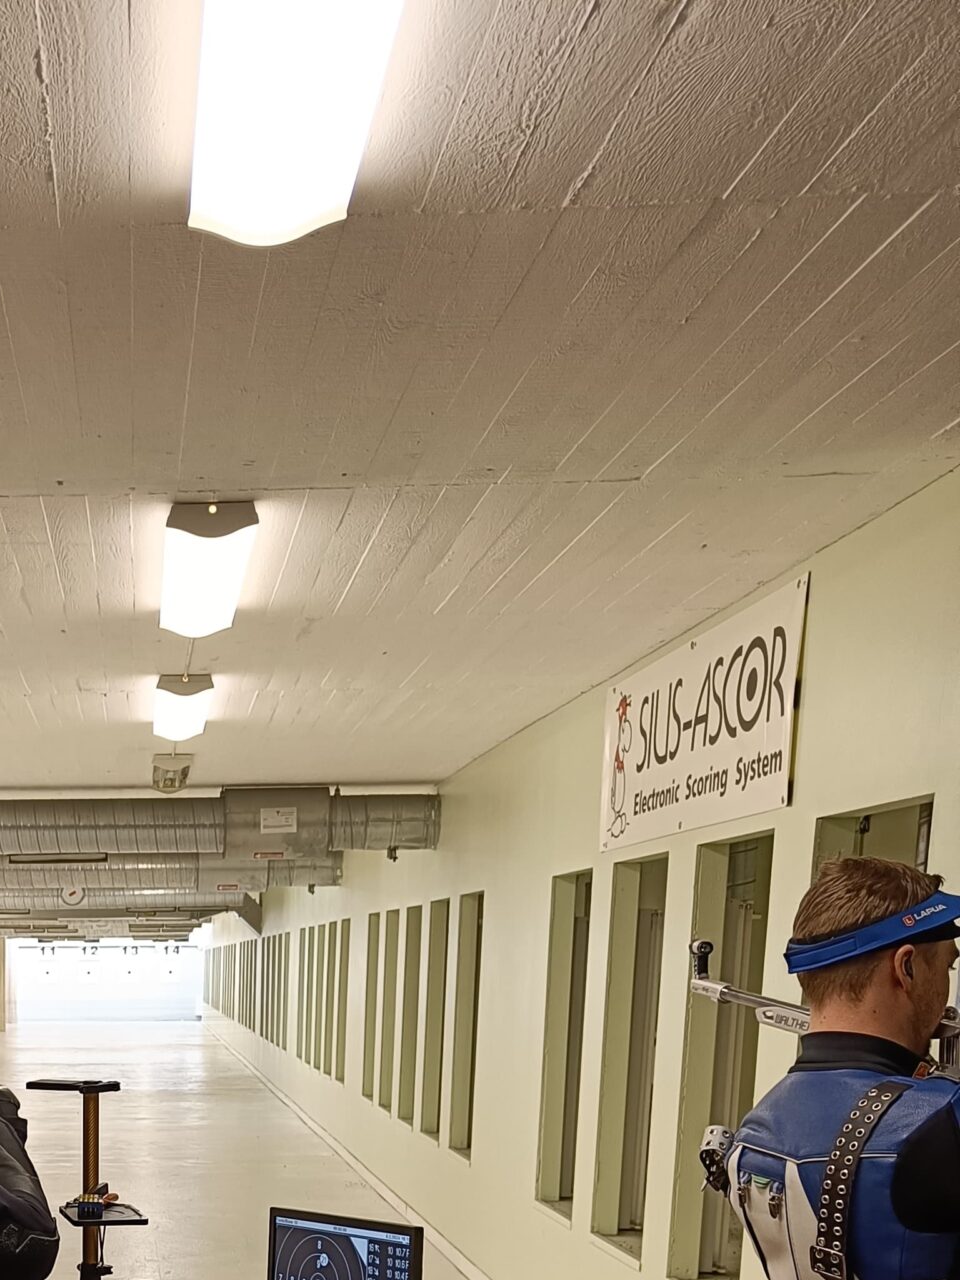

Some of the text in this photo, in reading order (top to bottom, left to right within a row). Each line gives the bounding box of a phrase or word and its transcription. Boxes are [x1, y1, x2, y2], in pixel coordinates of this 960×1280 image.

[636, 625, 788, 774] SIUS-ASCOR
[633, 749, 783, 817] Electronic Scoring System
[913, 904, 948, 920] LAPUA
[81, 945, 99, 955] 12
[163, 945, 180, 955] 14
[774, 1013, 810, 1032] WALTHE
